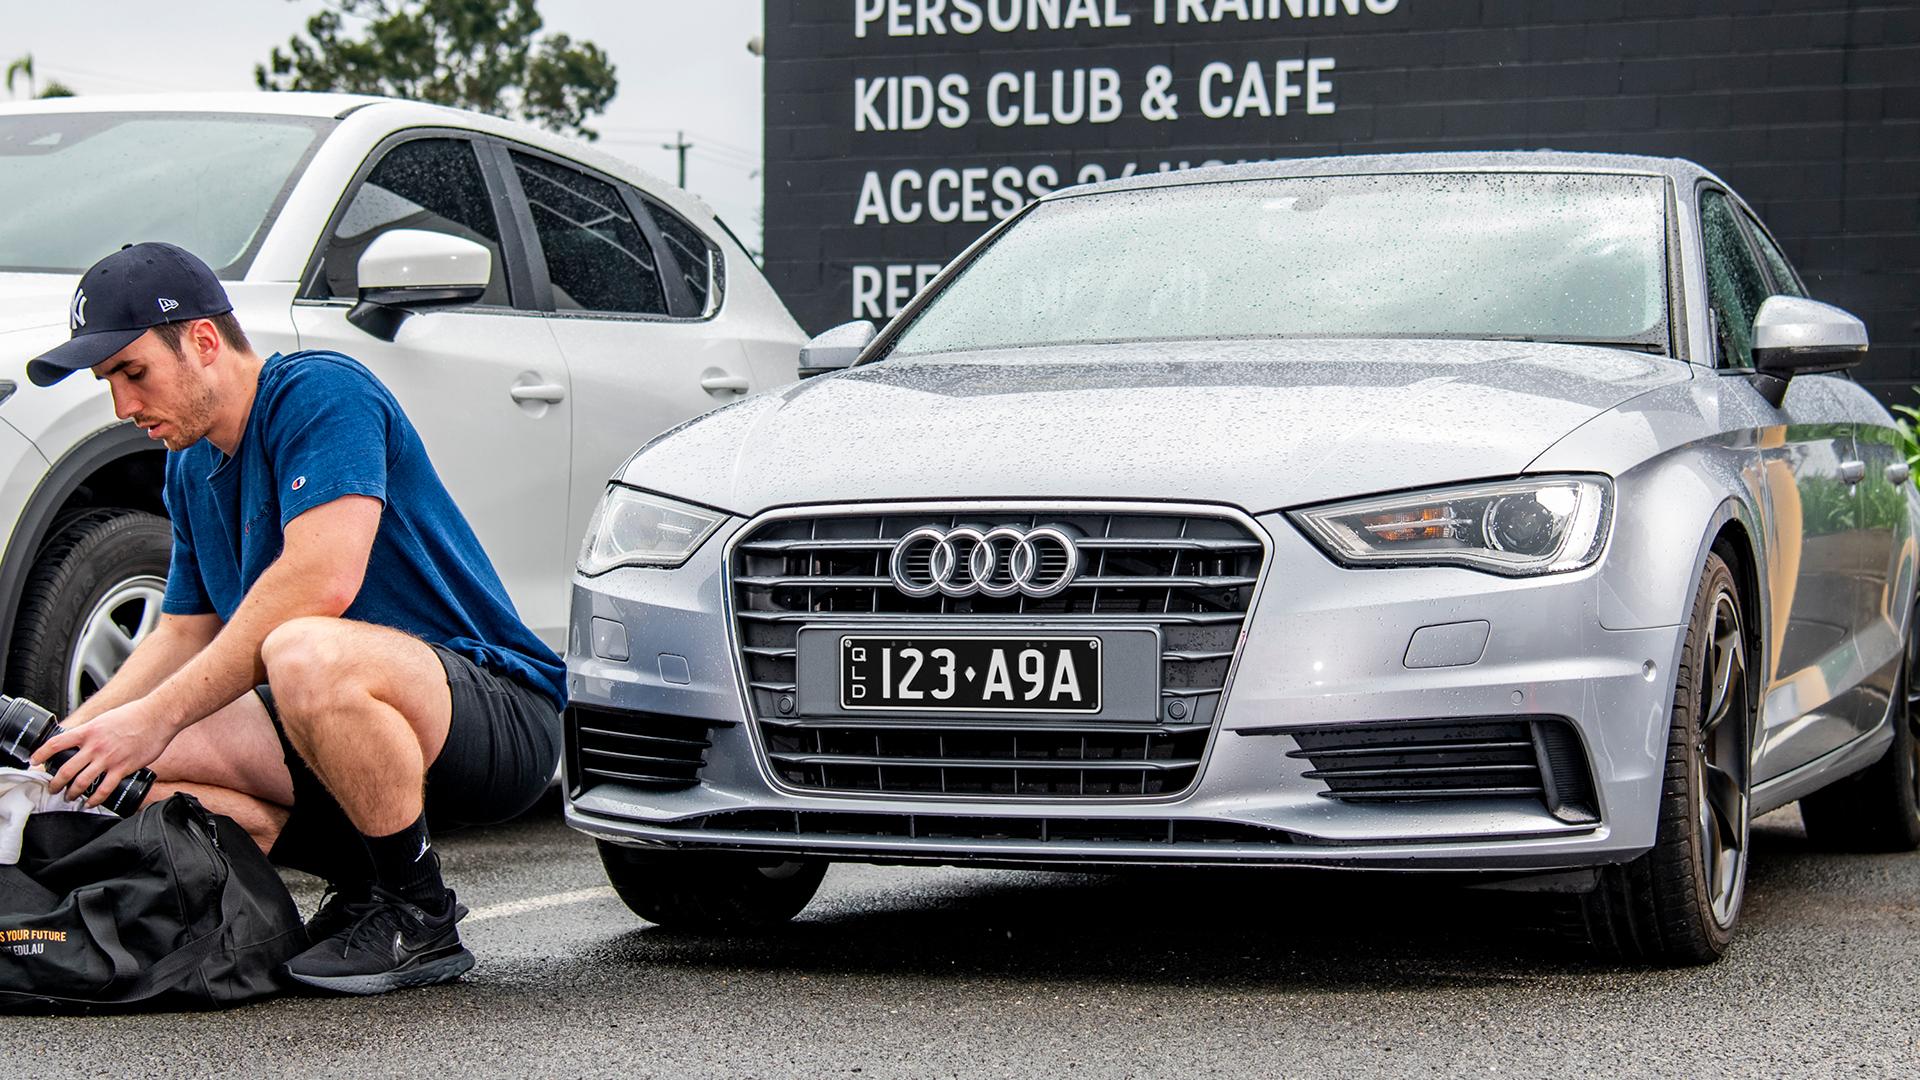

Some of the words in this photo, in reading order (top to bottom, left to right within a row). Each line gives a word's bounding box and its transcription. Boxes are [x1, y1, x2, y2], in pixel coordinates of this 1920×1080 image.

[854, 0, 1131, 38] PERSONAL
[854, 73, 971, 132] KIDS
[986, 67, 1123, 127] CLUB
[1140, 64, 1179, 121] &
[1198, 57, 1336, 118] CAFE
[853, 164, 1059, 225] ACCESS
[851, 647, 867, 699] QLD
[6, 929, 30, 942] YOUR
[31, 929, 67, 942] FUTURE
